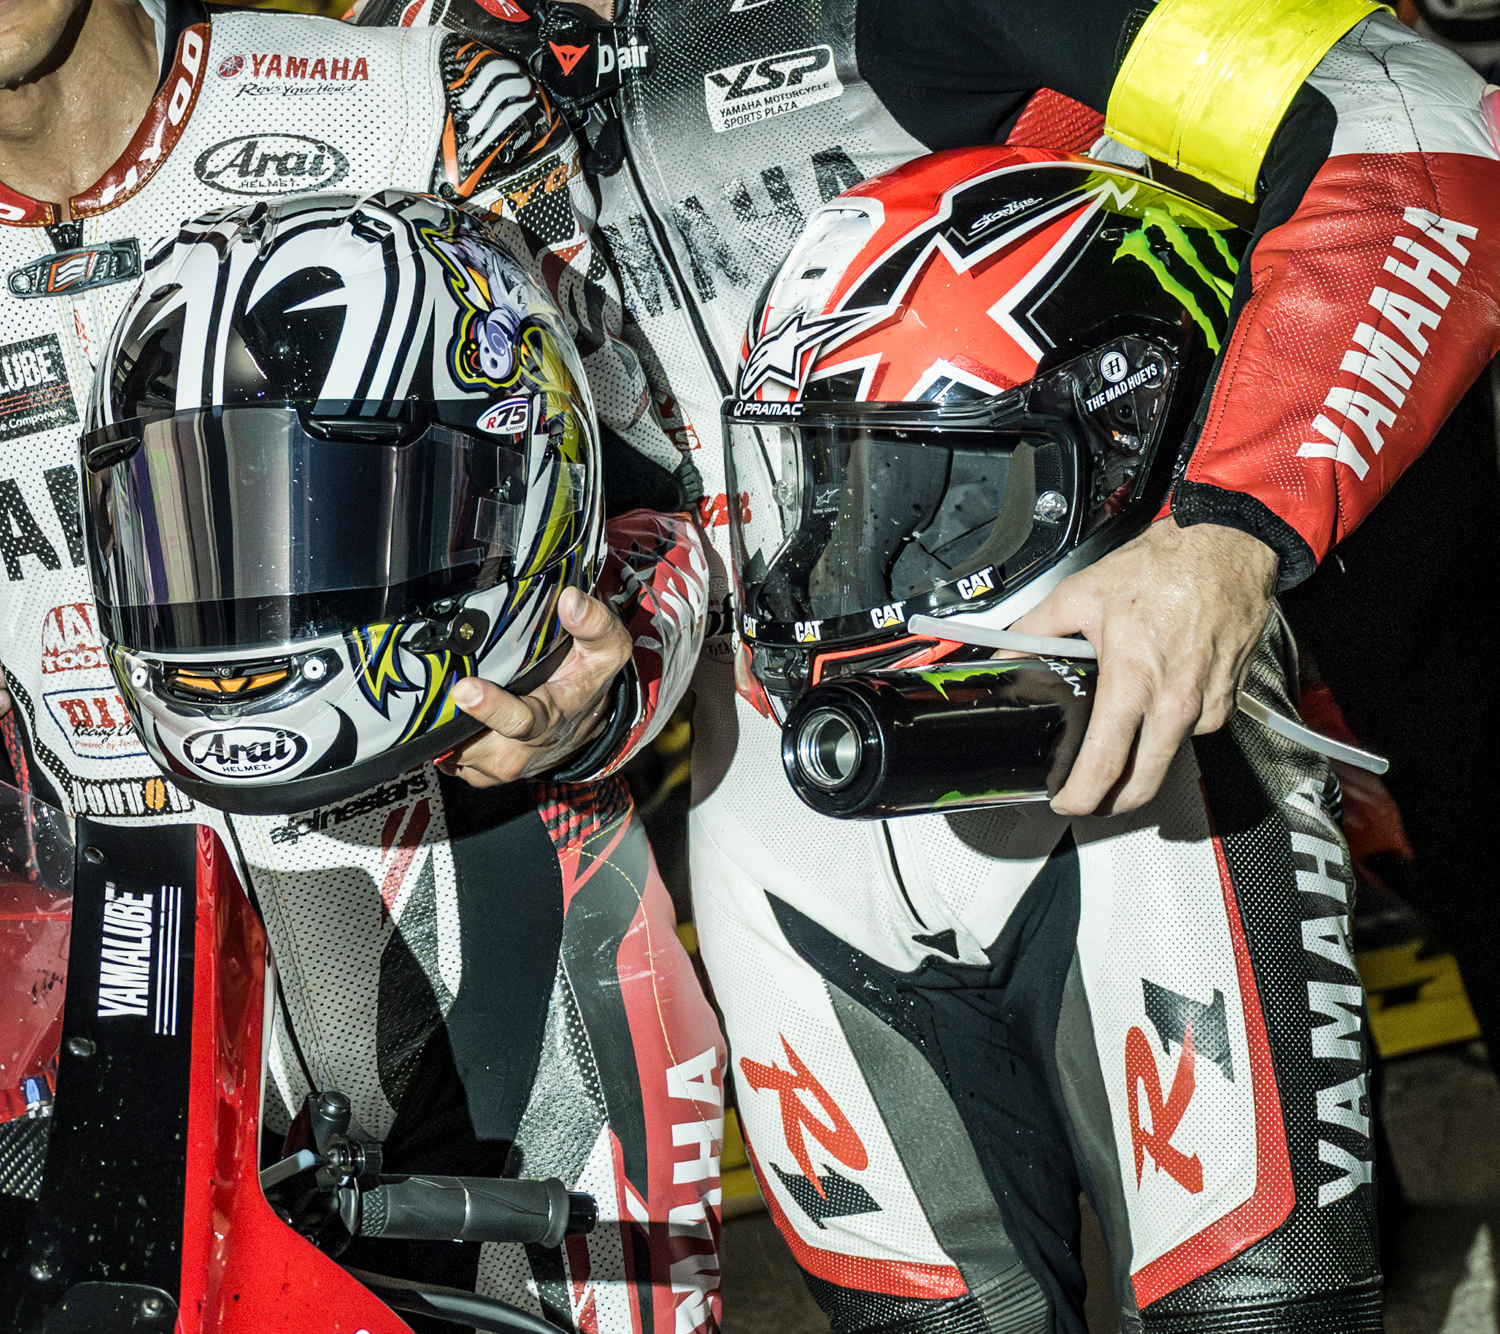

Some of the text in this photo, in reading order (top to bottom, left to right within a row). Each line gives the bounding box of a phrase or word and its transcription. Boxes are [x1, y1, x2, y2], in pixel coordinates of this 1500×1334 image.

[252, 54, 369, 81] YAMAHA
[707, 47, 830, 101] YSP
[236, 84, 283, 97] Revs
[719, 82, 830, 117] YAMAHA MOTORCYCLE
[724, 100, 798, 129] SPORTS PLAZA
[201, 140, 328, 181] Arai
[1296, 207, 1479, 481] YAMAHA
[1086, 363, 1158, 412] THE MAD HUEYS
[9, 408, 68, 431] Component
[742, 403, 803, 416] PRAMAC
[957, 567, 994, 599] CAT
[794, 621, 822, 642] CAT
[871, 601, 905, 629] CAT
[107, 741, 116, 750] by
[193, 730, 291, 765] Arai
[97, 887, 154, 1019] YAMALUBE
[1284, 778, 1373, 1209] YAMAHA
[1125, 977, 1234, 1195] R1
